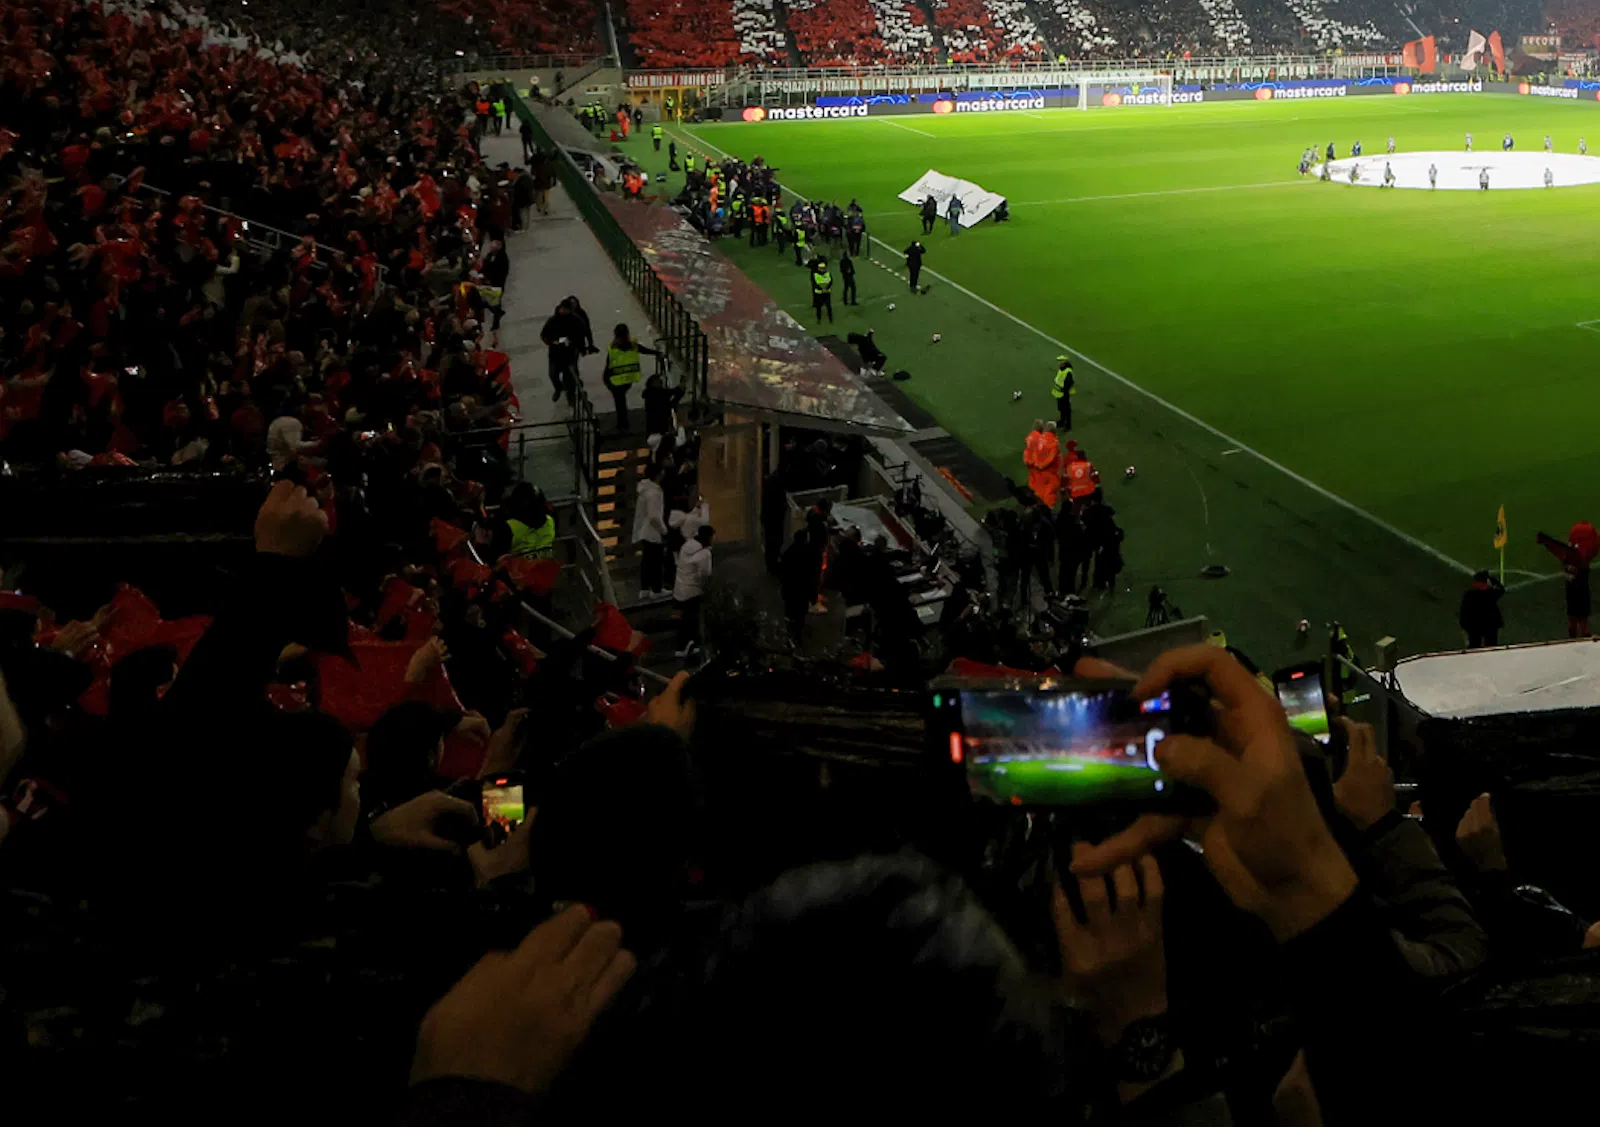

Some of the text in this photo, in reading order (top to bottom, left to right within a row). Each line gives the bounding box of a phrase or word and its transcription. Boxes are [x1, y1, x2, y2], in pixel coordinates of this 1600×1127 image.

[1175, 67, 1234, 80] FAMILY
[1241, 65, 1270, 78] DAY
[1273, 85, 1346, 99] mastercard
[1412, 78, 1483, 92] mastercard
[1530, 85, 1578, 98] mastercard
[956, 96, 1044, 112] mastercard
[1123, 90, 1203, 106] mastercard
[768, 104, 868, 121] mastercard
